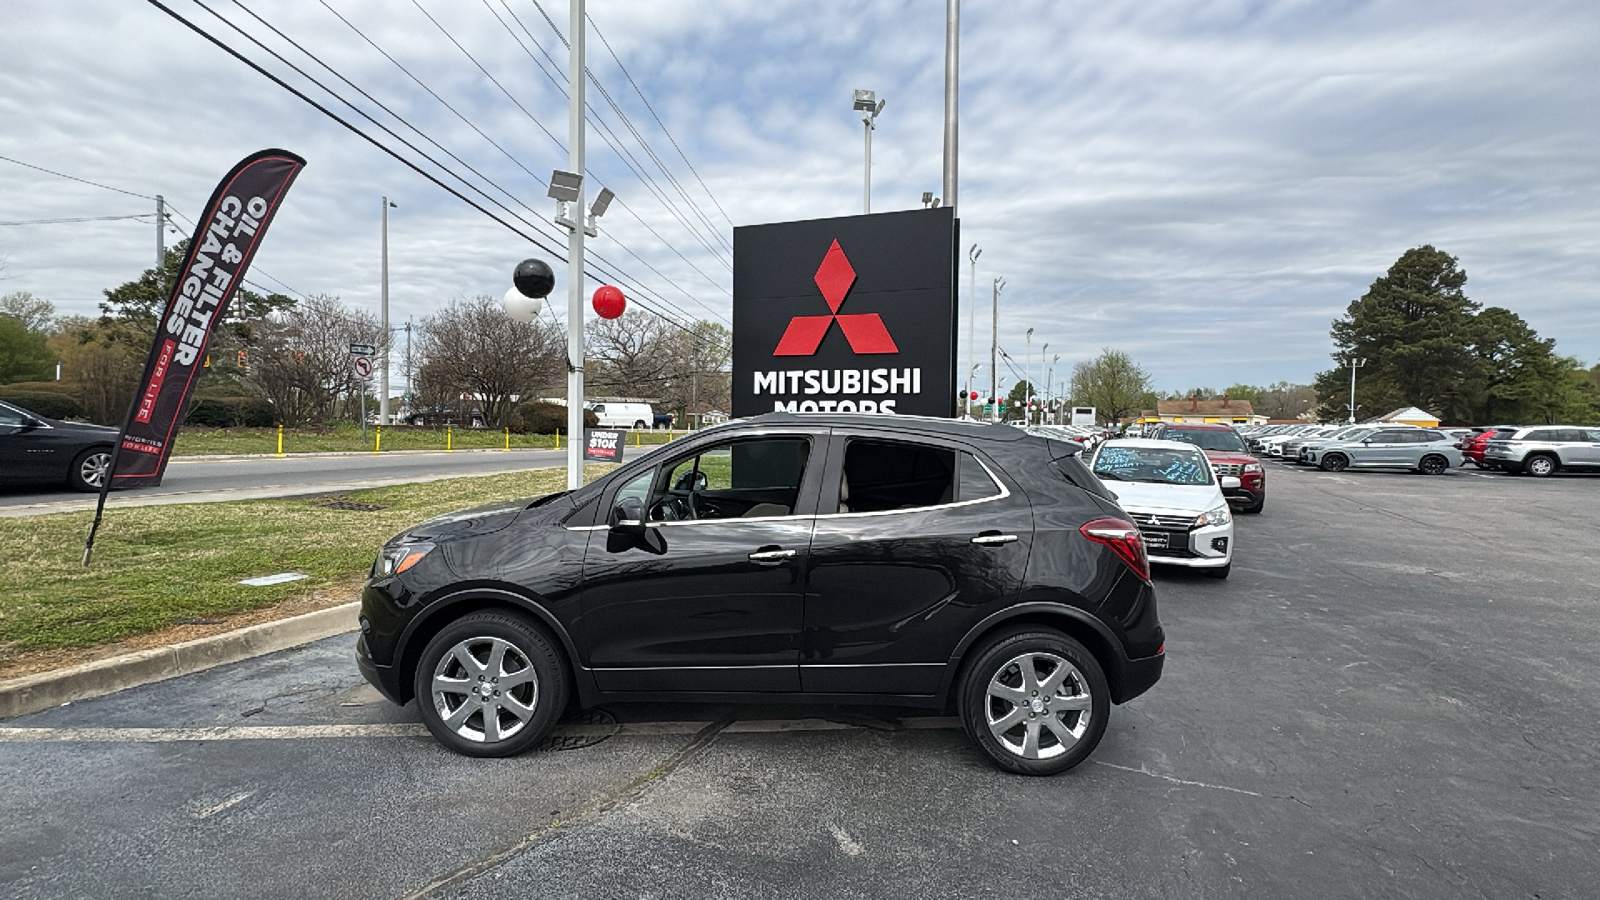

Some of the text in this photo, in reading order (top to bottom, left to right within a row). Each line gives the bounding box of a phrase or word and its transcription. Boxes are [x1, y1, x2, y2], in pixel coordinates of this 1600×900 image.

[167, 195, 242, 334] CHANGES
[173, 196, 267, 366] OIL & FILTER
[138, 344, 172, 418] FOR LIFE
[753, 367, 921, 395] MITSUBISHI
[774, 399, 896, 414] MOTORS
[589, 438, 617, 449] $10K
[591, 431, 619, 440] UNDER
